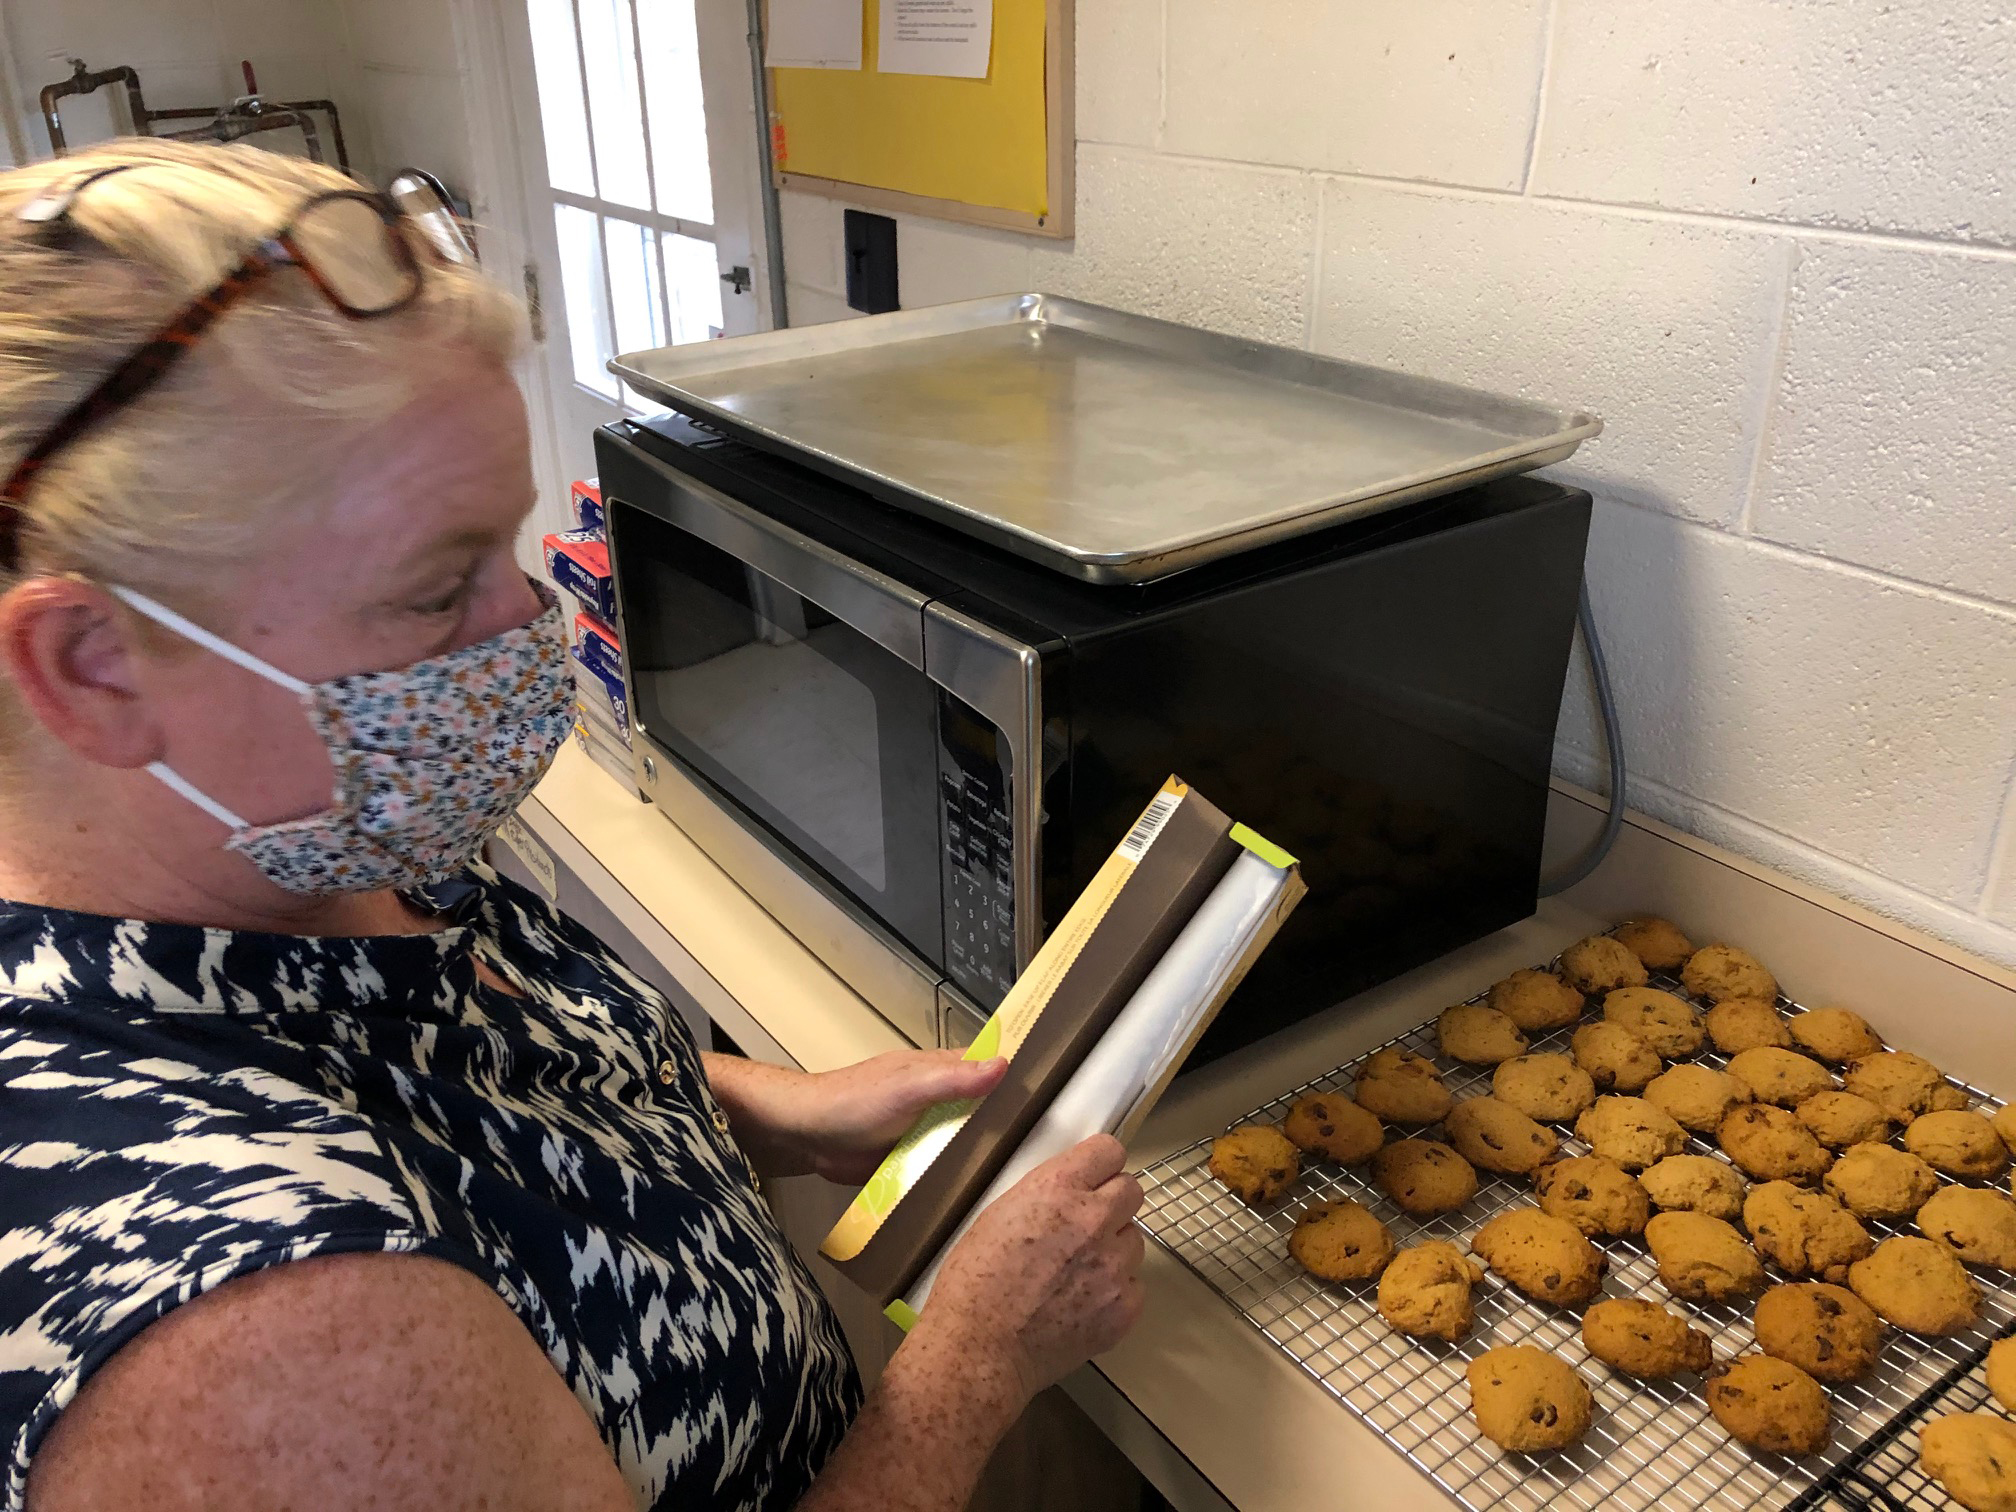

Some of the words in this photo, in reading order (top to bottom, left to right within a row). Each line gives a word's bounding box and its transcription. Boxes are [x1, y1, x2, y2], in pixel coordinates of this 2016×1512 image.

[568, 562, 587, 583] Sheets
[586, 575, 597, 591] Foil
[600, 642, 618, 663] Sheets
[613, 695, 626, 715] 30
[954, 874, 959, 885] 1
[968, 885, 973, 895] 2
[954, 898, 960, 908] 4
[982, 895, 988, 906] 3
[968, 908, 974, 919] 5
[955, 921, 960, 931] 7
[982, 919, 988, 930] 6
[969, 932, 975, 942] 8
[983, 943, 989, 954] 9
[969, 955, 975, 966] 0
